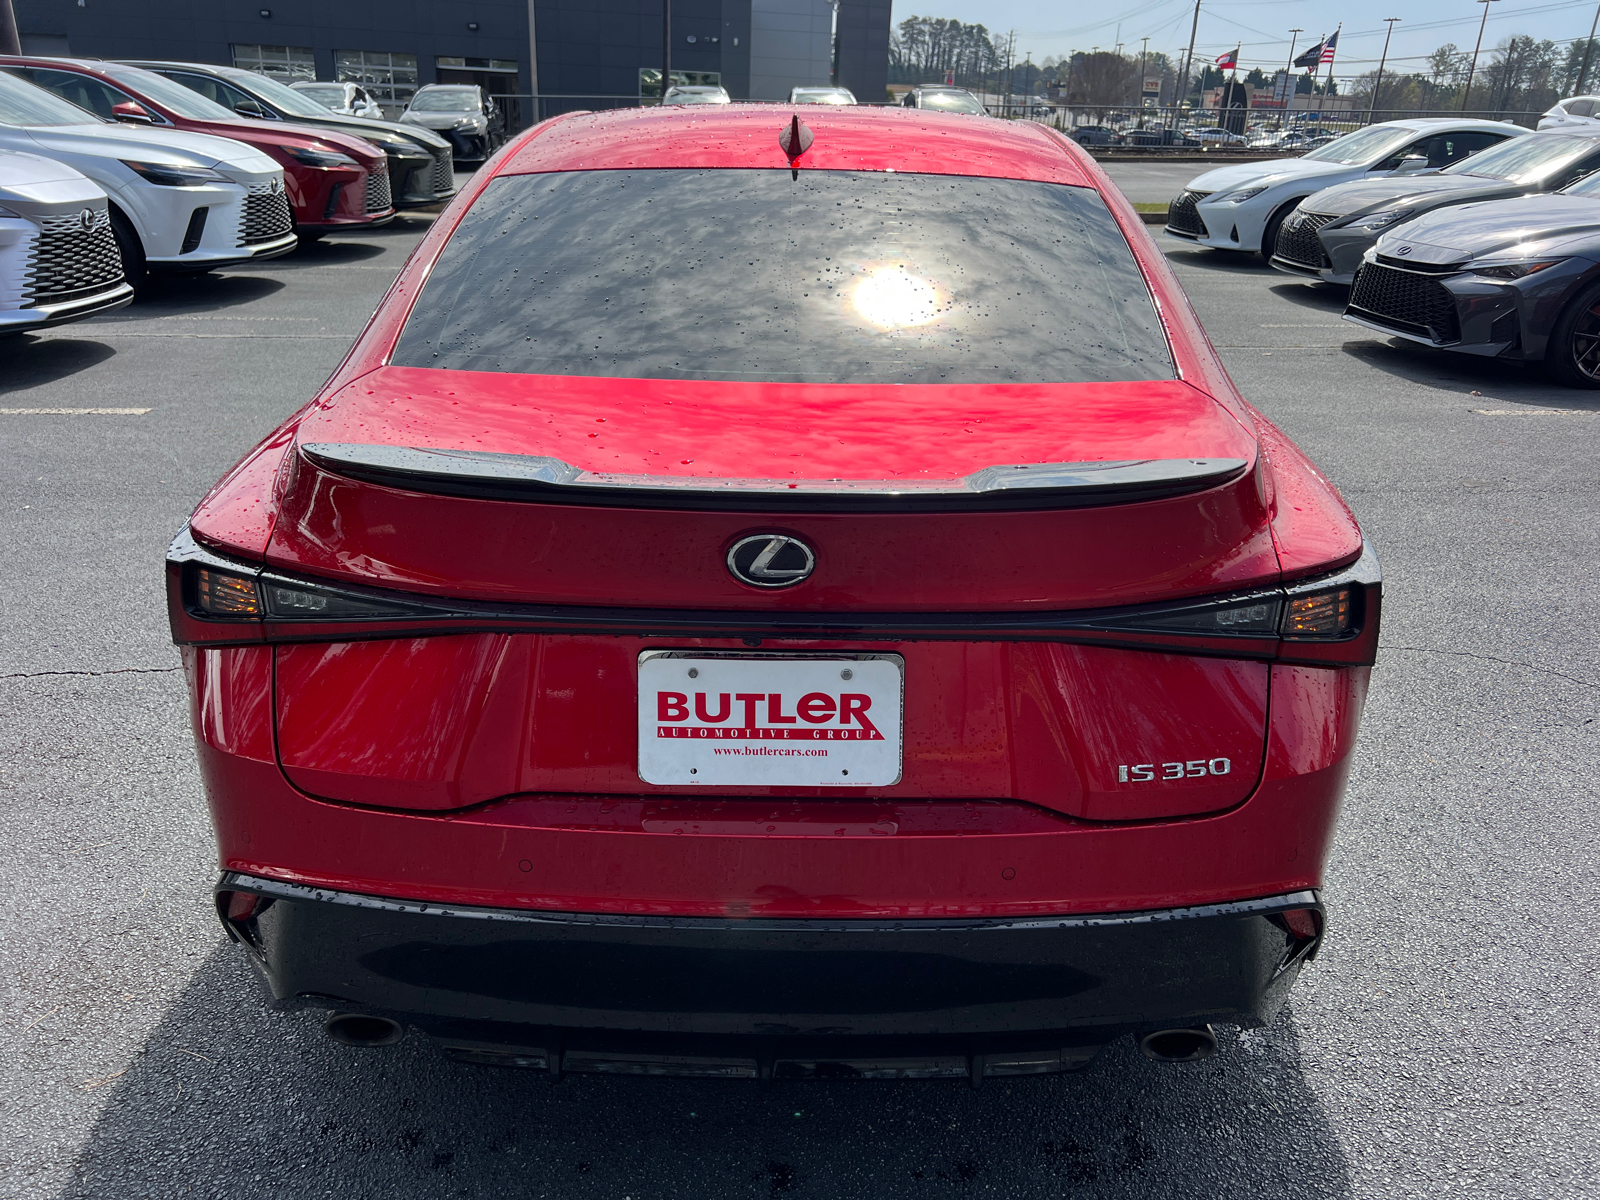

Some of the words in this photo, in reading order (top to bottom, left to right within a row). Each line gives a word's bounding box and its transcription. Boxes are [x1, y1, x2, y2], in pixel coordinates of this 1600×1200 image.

[658, 727, 790, 739] AUTOMOTIVE
[813, 729, 876, 739] GROUP
[713, 746, 828, 757] www.butlercars.com
[1118, 764, 1155, 782] IS
[1162, 757, 1231, 780] 350
